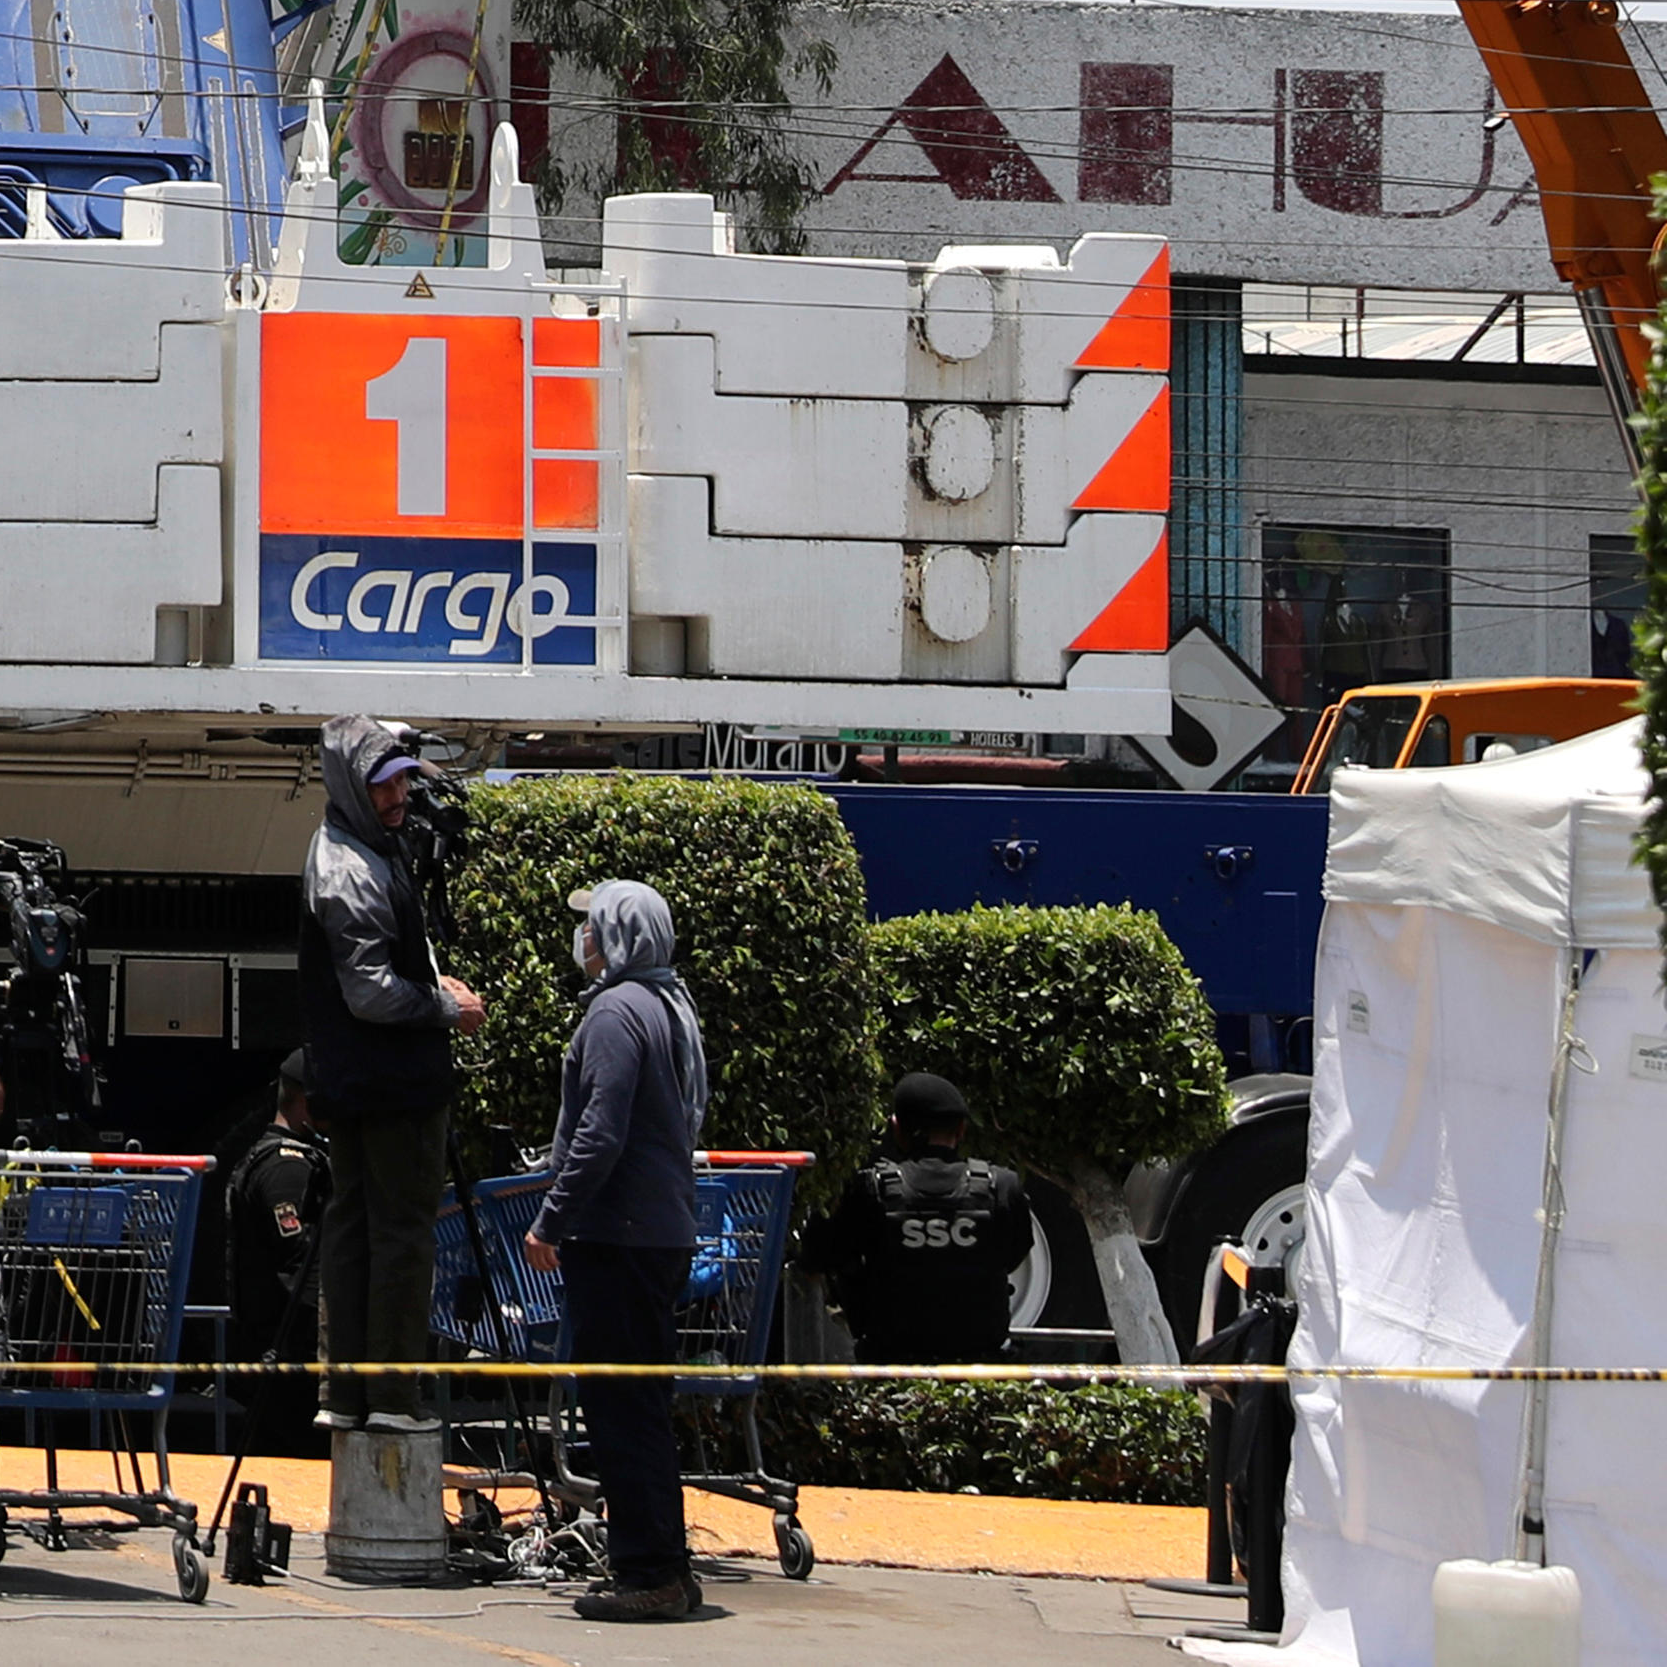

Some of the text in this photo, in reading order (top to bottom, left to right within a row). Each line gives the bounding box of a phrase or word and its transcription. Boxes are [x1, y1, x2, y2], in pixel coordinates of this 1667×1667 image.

[366, 337, 447, 516] 1
[289, 551, 570, 656] Cargo
[970, 733, 1016, 747] HOTELES
[901, 1218, 977, 1248] SSC
